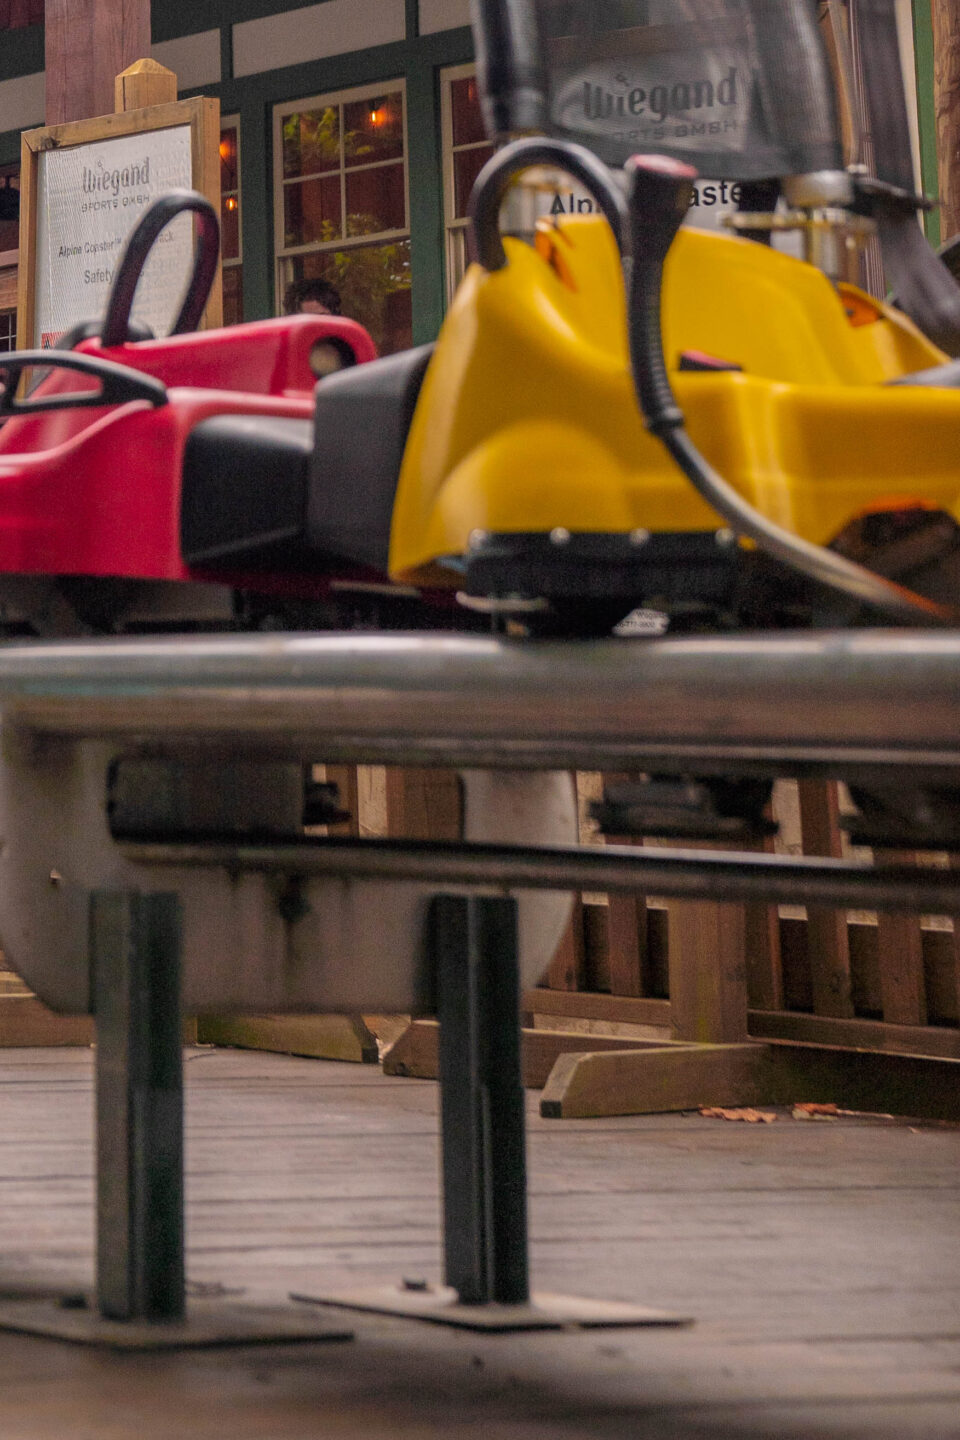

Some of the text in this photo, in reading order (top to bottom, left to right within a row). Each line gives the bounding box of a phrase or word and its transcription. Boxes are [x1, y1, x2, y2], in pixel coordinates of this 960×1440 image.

[583, 66, 737, 123] Wiegand
[82, 156, 150, 196] Wiegand
[550, 192, 593, 215] Alp
[84, 267, 114, 284] Safety
